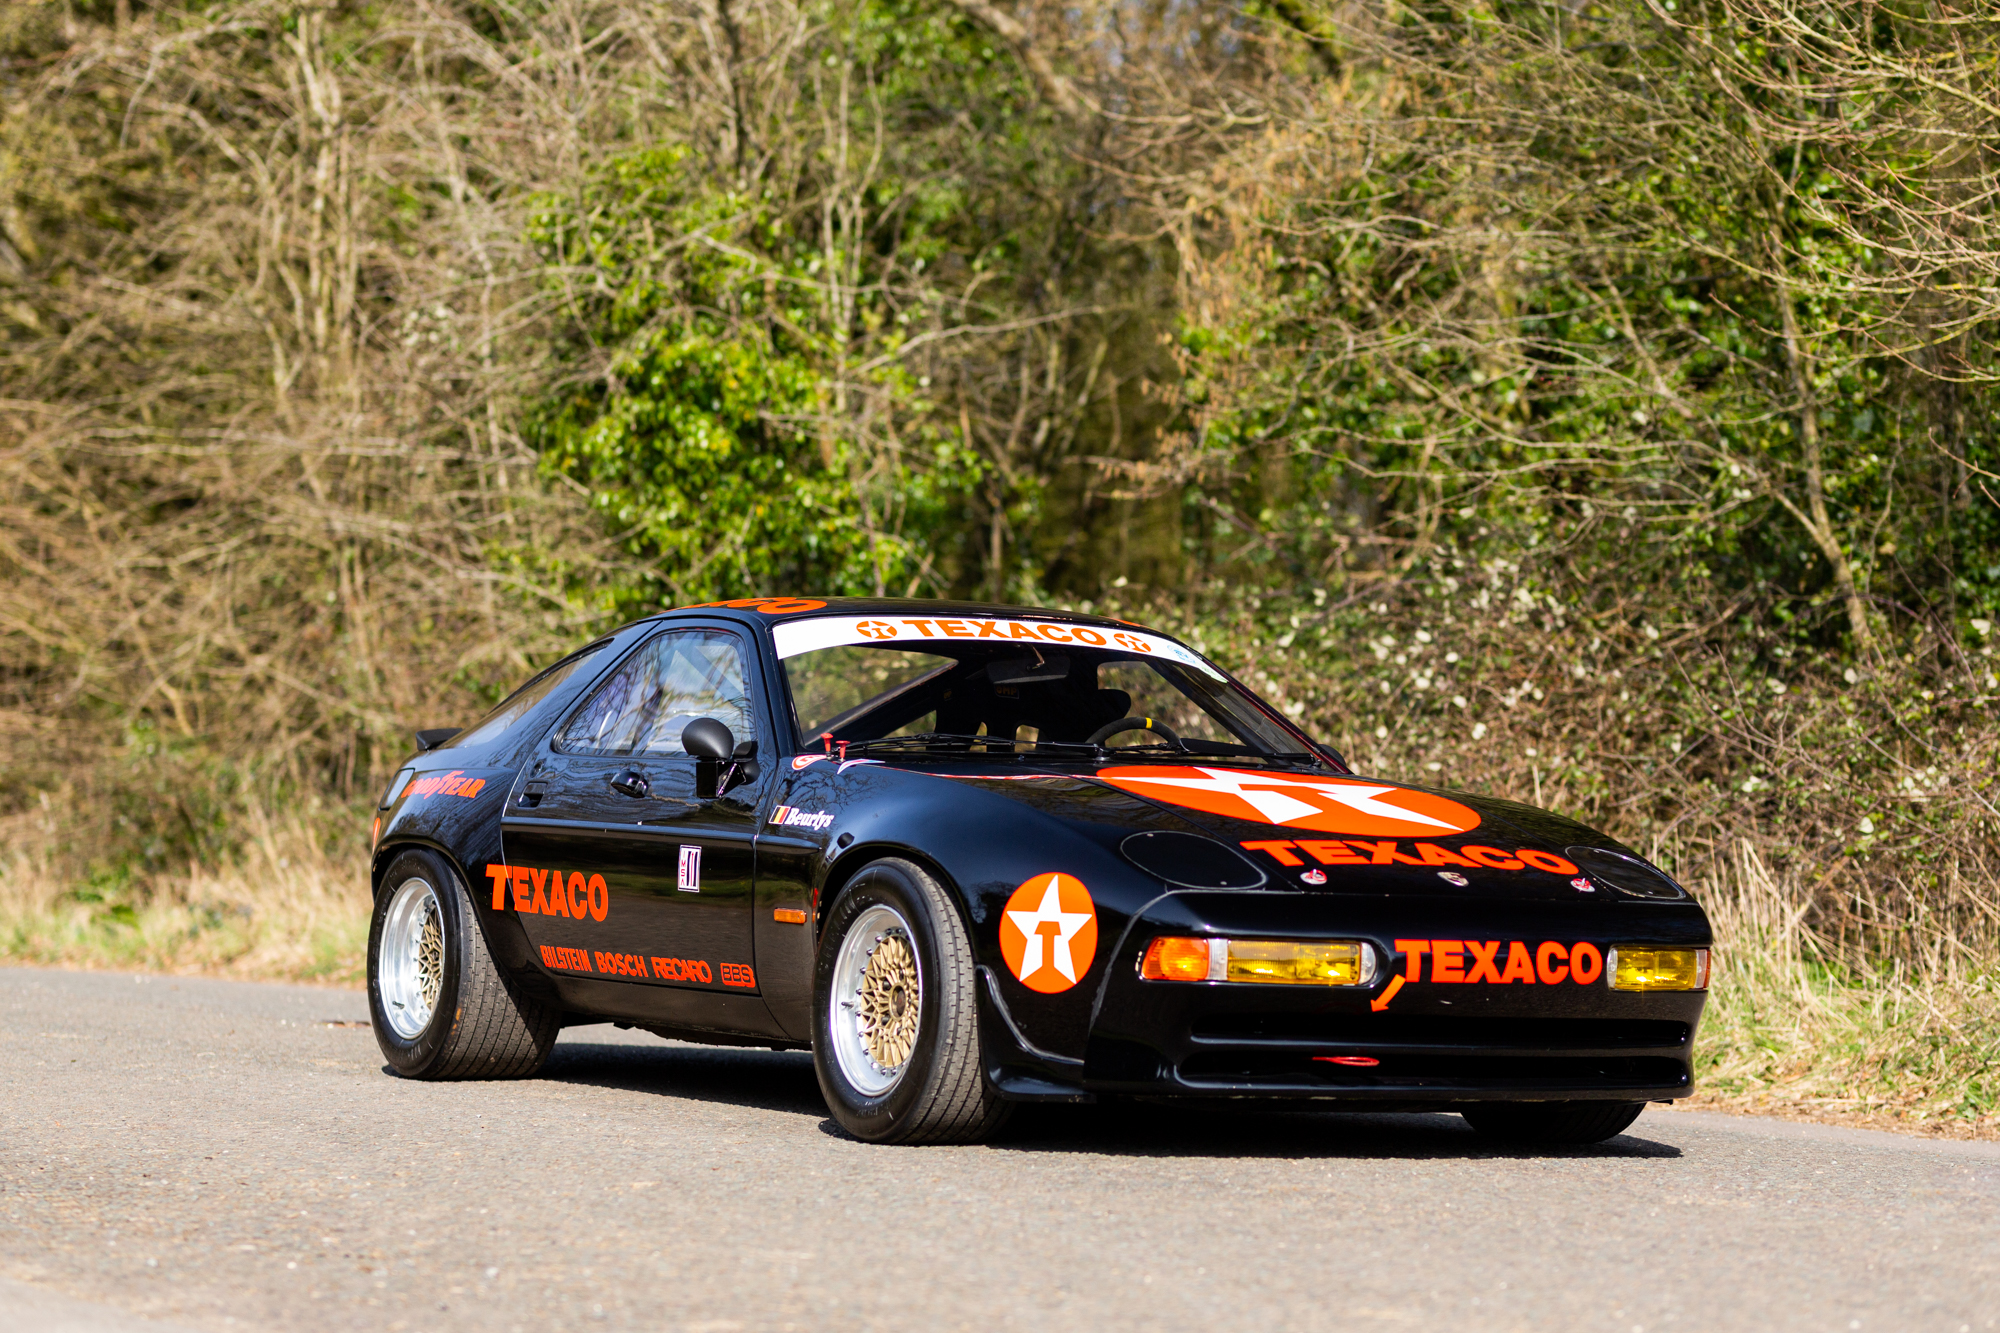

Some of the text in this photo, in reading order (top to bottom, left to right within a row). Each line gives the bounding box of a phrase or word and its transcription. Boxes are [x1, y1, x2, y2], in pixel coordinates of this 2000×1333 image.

[901, 619, 1107, 646] TEXACO
[400, 770, 486, 800] GOODYEAR
[784, 807, 835, 831] Beurlys
[1239, 839, 1579, 875] TEXACO
[485, 863, 609, 922] TEXACO
[539, 945, 755, 987] BILSTEIN BOSCH RECARO BBS
[1394, 939, 1603, 985] TEXACO
